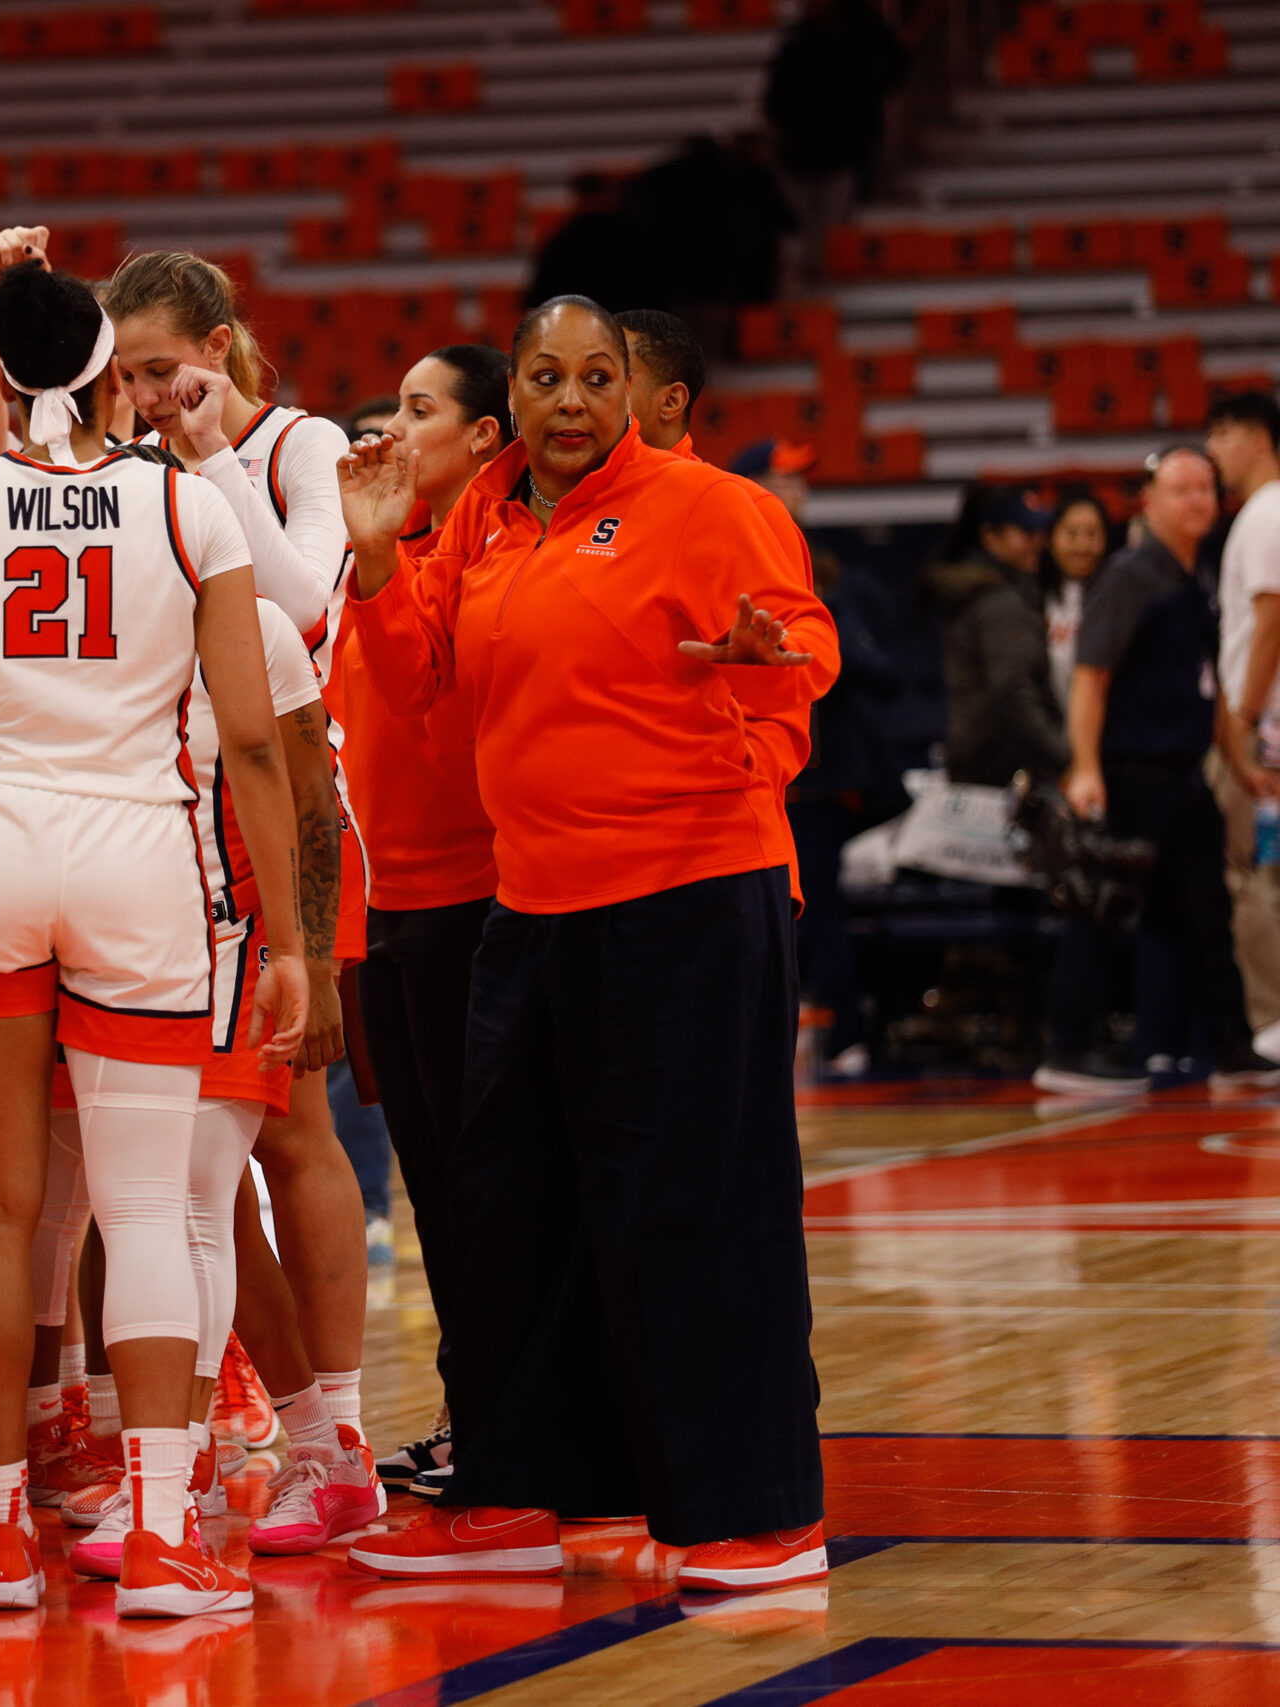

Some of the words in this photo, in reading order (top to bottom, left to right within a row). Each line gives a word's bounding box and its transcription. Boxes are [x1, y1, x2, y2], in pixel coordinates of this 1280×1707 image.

[7, 485, 120, 531] WILSON
[590, 517, 621, 545] S
[3, 545, 118, 659] 21
